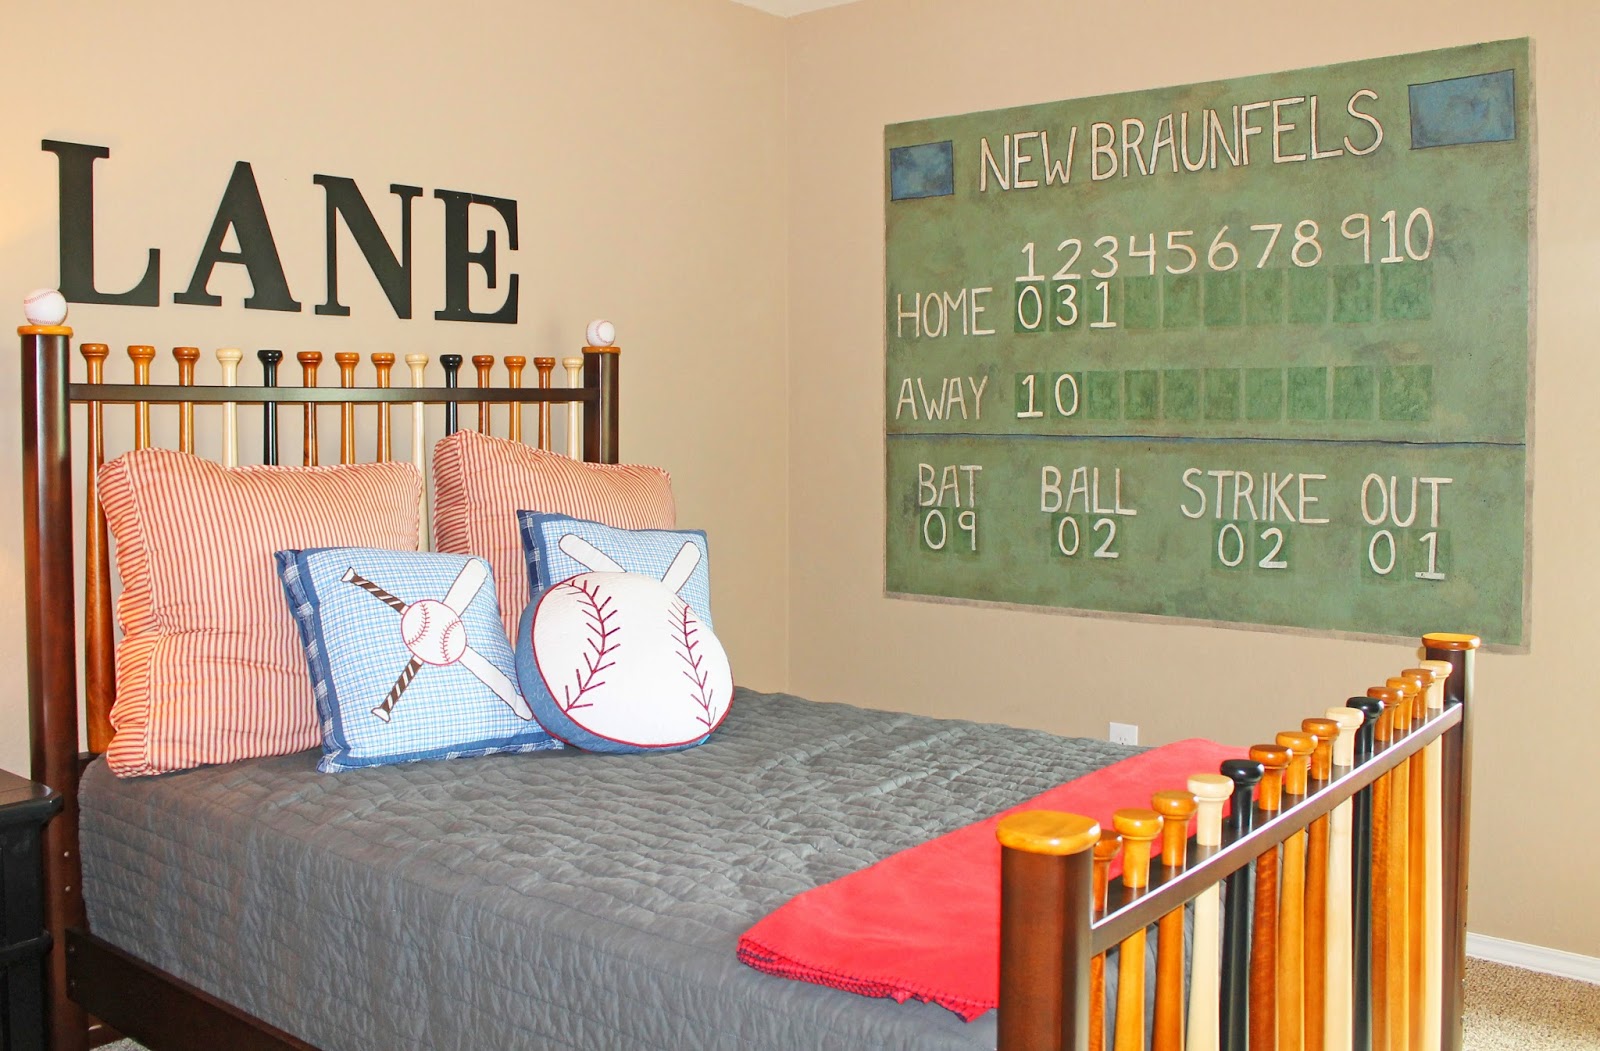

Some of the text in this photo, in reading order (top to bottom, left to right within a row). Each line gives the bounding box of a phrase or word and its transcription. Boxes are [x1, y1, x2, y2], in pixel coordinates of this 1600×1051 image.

[978, 89, 1385, 193] NEW BRAUNFELS
[41, 139, 519, 324] LANE
[897, 287, 995, 338] HOME
[896, 376, 988, 421] AWAY
[918, 463, 983, 508] BAT
[1041, 465, 1137, 516] BALL
[1180, 467, 1330, 524] STRIKE
[1360, 473, 1453, 528] OUT
